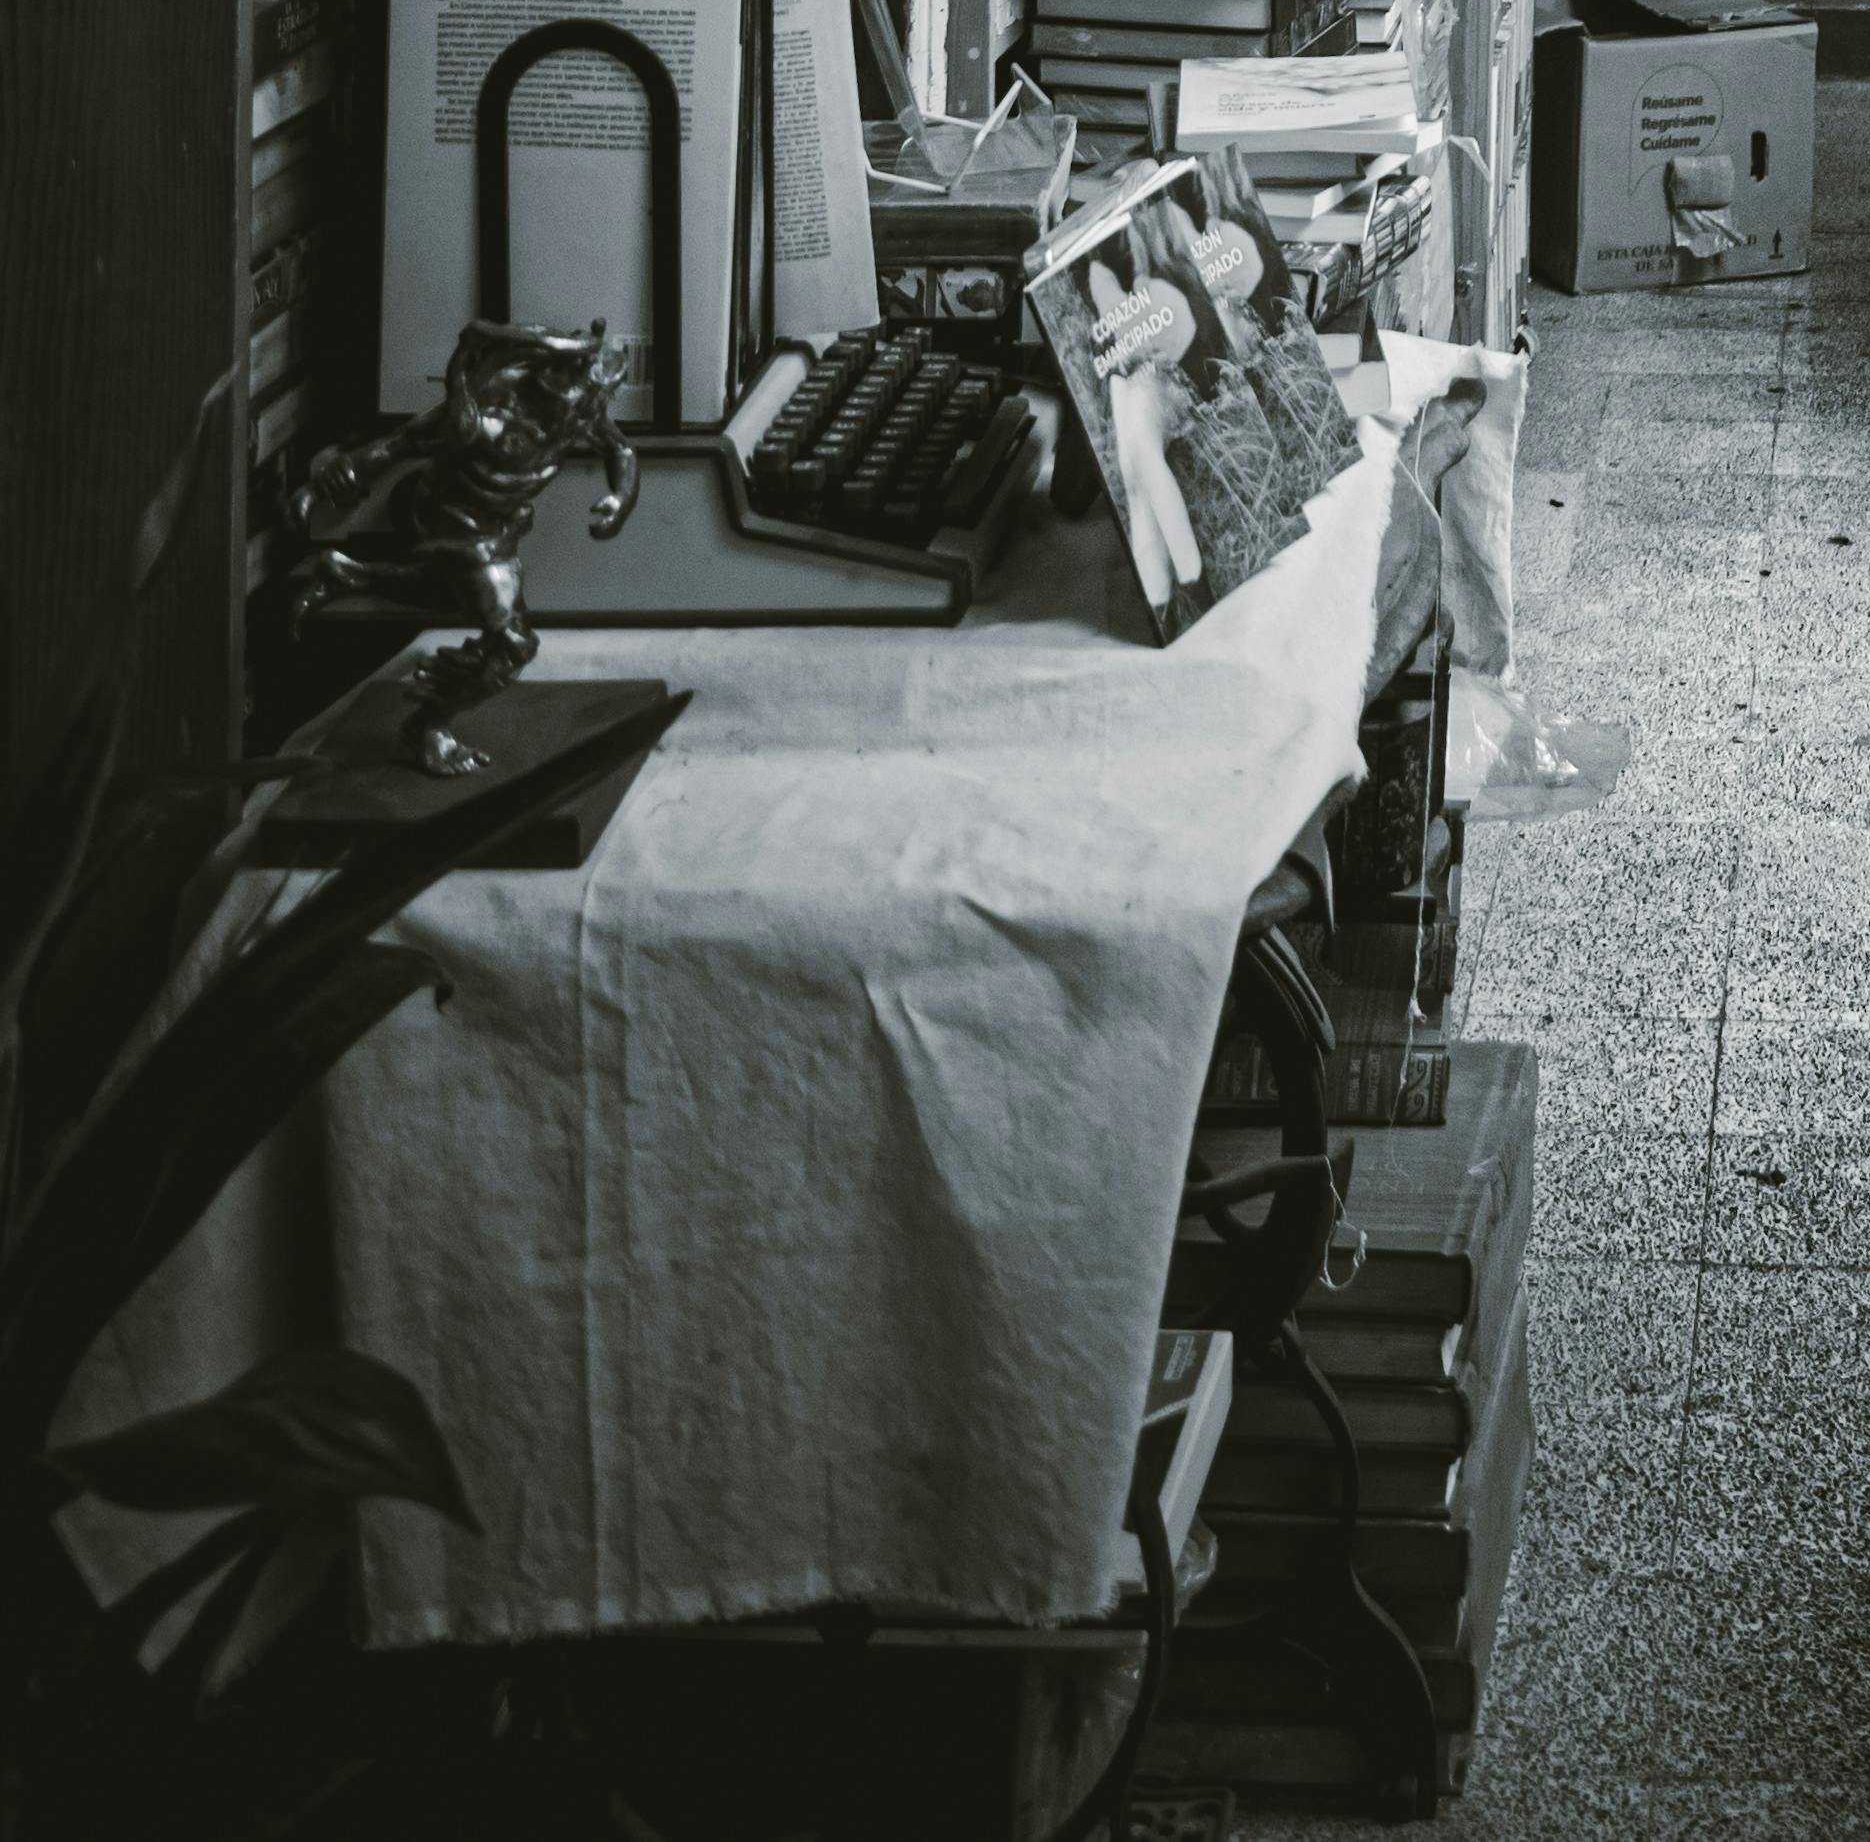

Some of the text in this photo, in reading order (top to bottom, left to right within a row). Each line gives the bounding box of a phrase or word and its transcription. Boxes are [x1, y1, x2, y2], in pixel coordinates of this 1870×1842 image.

[1641, 95, 1704, 111] Reúsame
[1641, 113, 1716, 133] Regrésame
[1640, 135, 1701, 151] Cuídame
[1596, 247, 1629, 261] ESTA
[1093, 286, 1151, 343] CORAZÓN
[1094, 306, 1174, 379] EMANCIPADO
